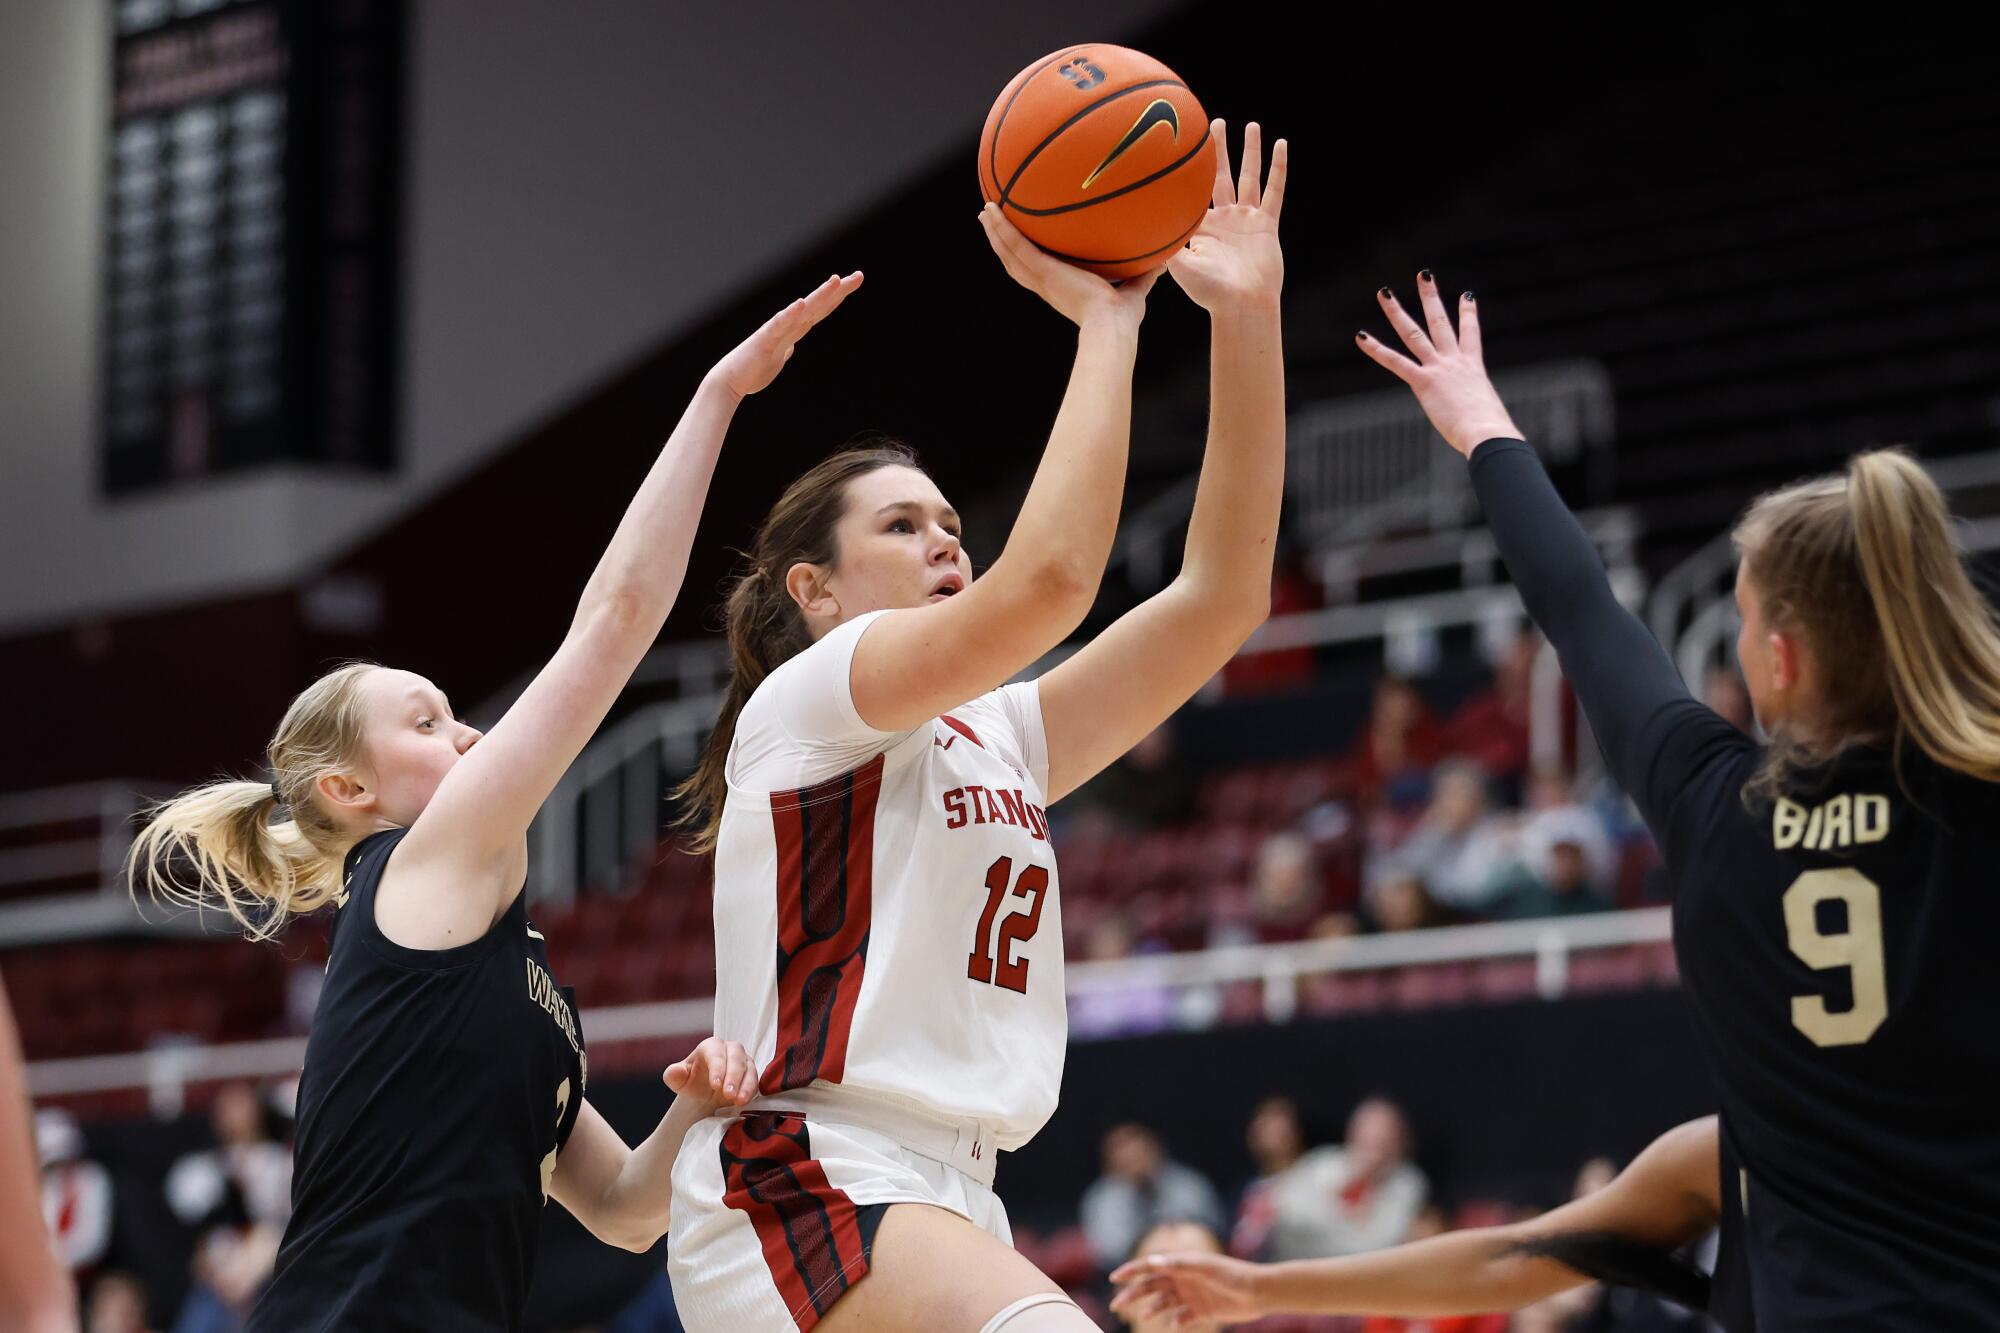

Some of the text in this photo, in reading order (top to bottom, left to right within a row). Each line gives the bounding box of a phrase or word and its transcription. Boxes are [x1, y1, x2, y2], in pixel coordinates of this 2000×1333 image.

[943, 785, 1052, 845] STANR
[1773, 793, 1890, 851] BIRD
[967, 855, 1049, 995] 12
[1782, 866, 1889, 1048] 9
